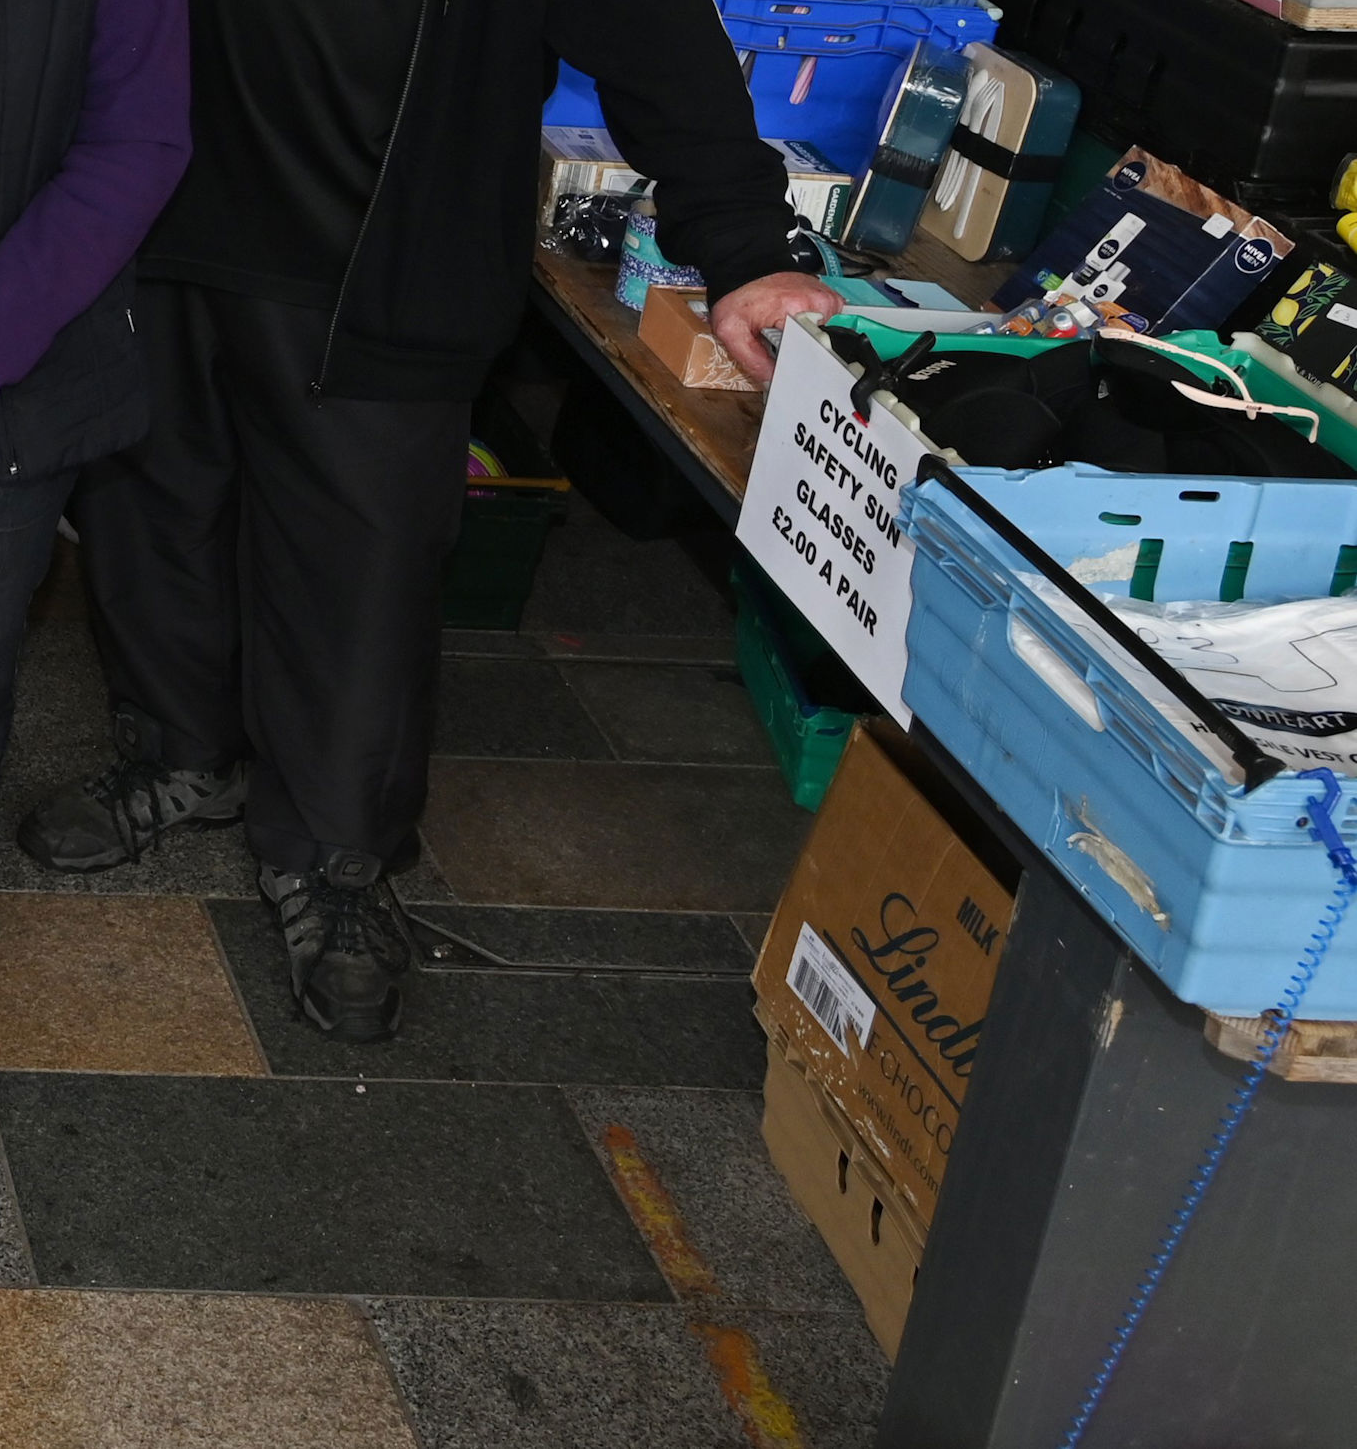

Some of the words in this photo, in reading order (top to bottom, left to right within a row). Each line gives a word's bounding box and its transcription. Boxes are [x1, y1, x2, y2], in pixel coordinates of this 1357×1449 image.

[1121, 167, 1141, 182] NIVEA
[1241, 252, 1260, 267] MEN
[1244, 244, 1267, 263] NIVEA
[820, 399, 897, 490] CYCLING
[794, 422, 863, 501] SAFETY
[865, 494, 901, 549] SUN
[797, 479, 876, 575] GLASSES
[772, 505, 817, 566] £2.00
[819, 559, 832, 586] A
[837, 574, 878, 637] PAIR
[1212, 702, 1347, 730] IONHEART
[1294, 746, 1345, 764] VEST
[956, 896, 1000, 957] MILK
[857, 1079, 941, 1196] www.lindt.com
[880, 1049, 954, 1156] CHOCO
